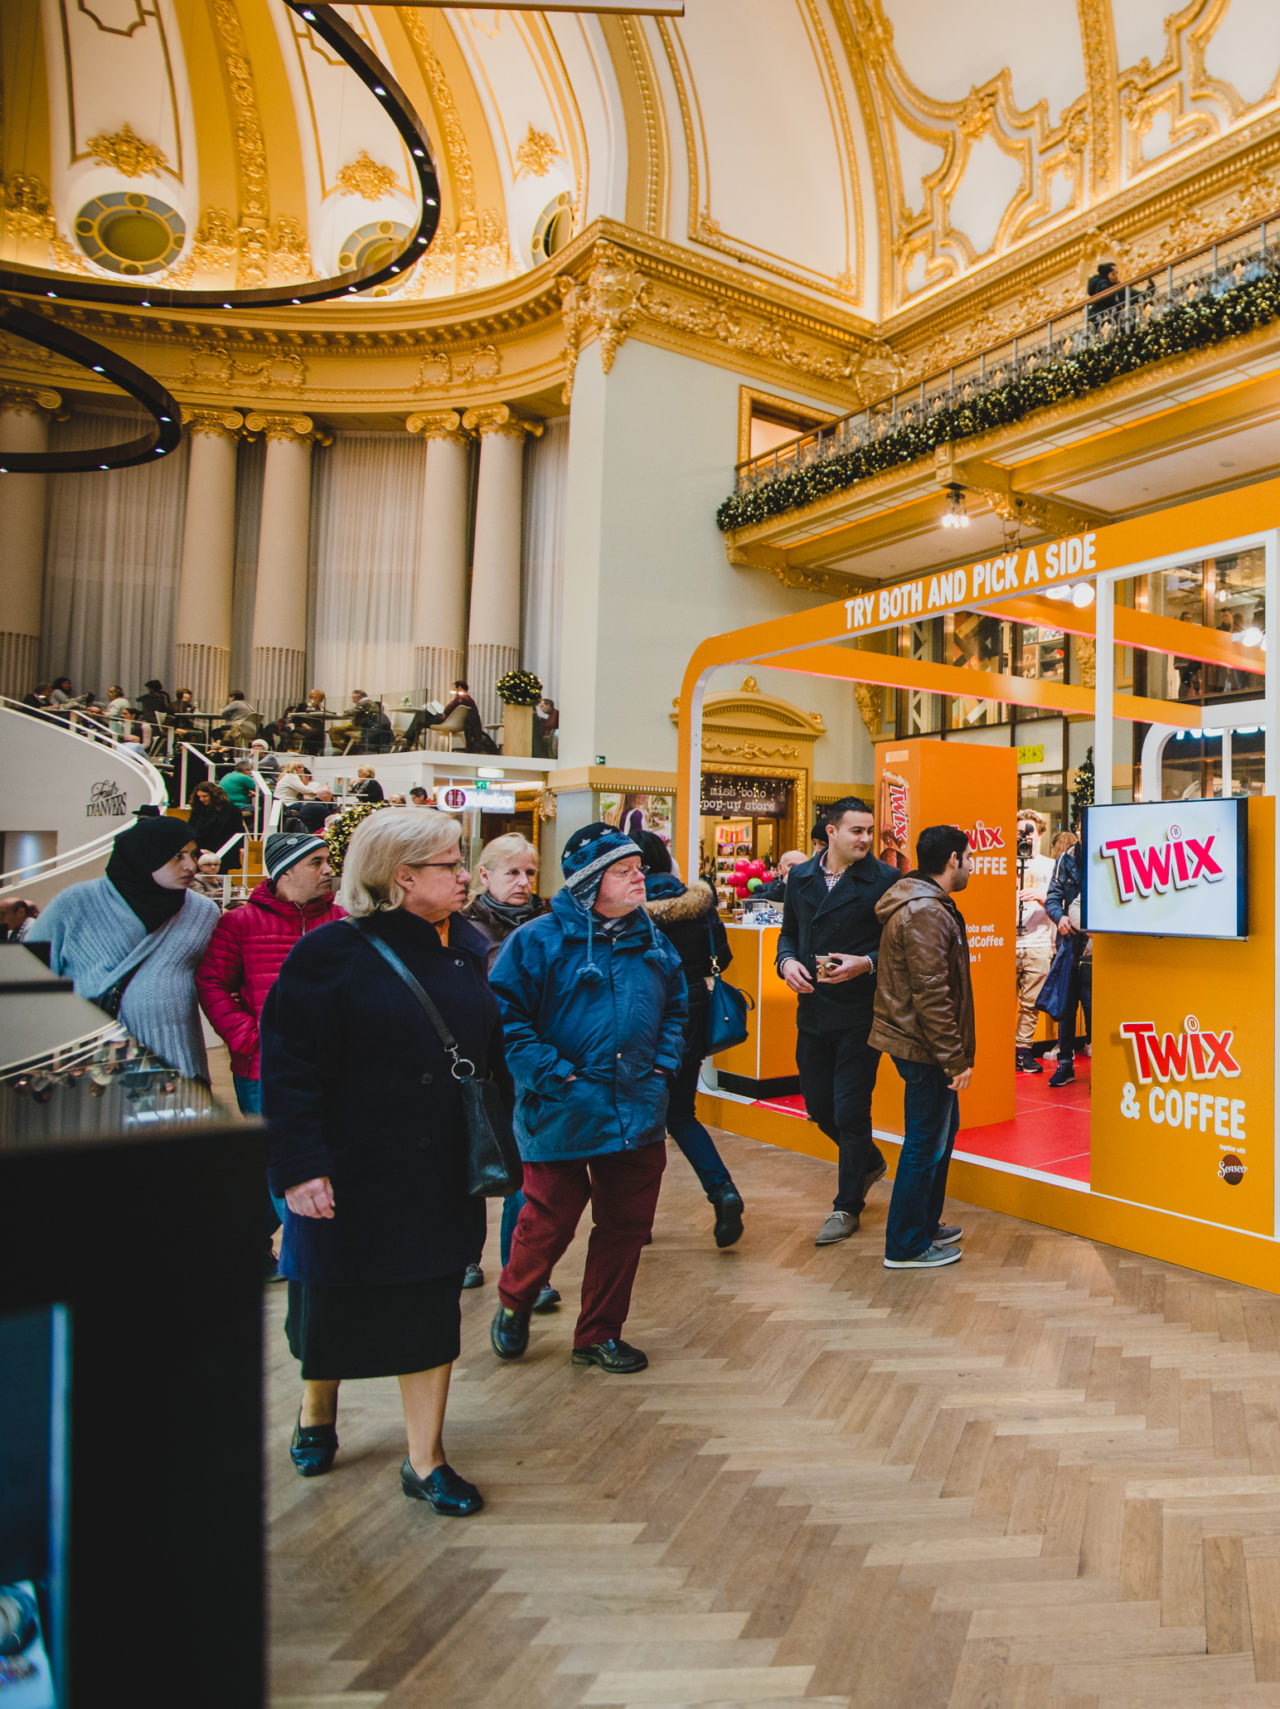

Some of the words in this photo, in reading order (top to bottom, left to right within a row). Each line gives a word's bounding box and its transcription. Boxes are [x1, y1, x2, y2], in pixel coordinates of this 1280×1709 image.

[844, 594, 875, 630] TRY
[879, 581, 923, 621] BOTH
[927, 569, 967, 609] AND
[973, 554, 1019, 598] PICK
[1024, 549, 1040, 585] A
[1045, 532, 1097, 579] SIDE
[702, 799, 741, 812] pop-up
[744, 800, 777, 812] store
[710, 787, 737, 797] miss
[963, 820, 1006, 853] wix
[968, 856, 1008, 875] OFFEE
[1101, 824, 1224, 902] Twix
[981, 923, 995, 933] met
[1120, 1014, 1241, 1084] Twix
[1120, 1081, 1141, 1120] &
[1148, 1086, 1247, 1140] COFFEE
